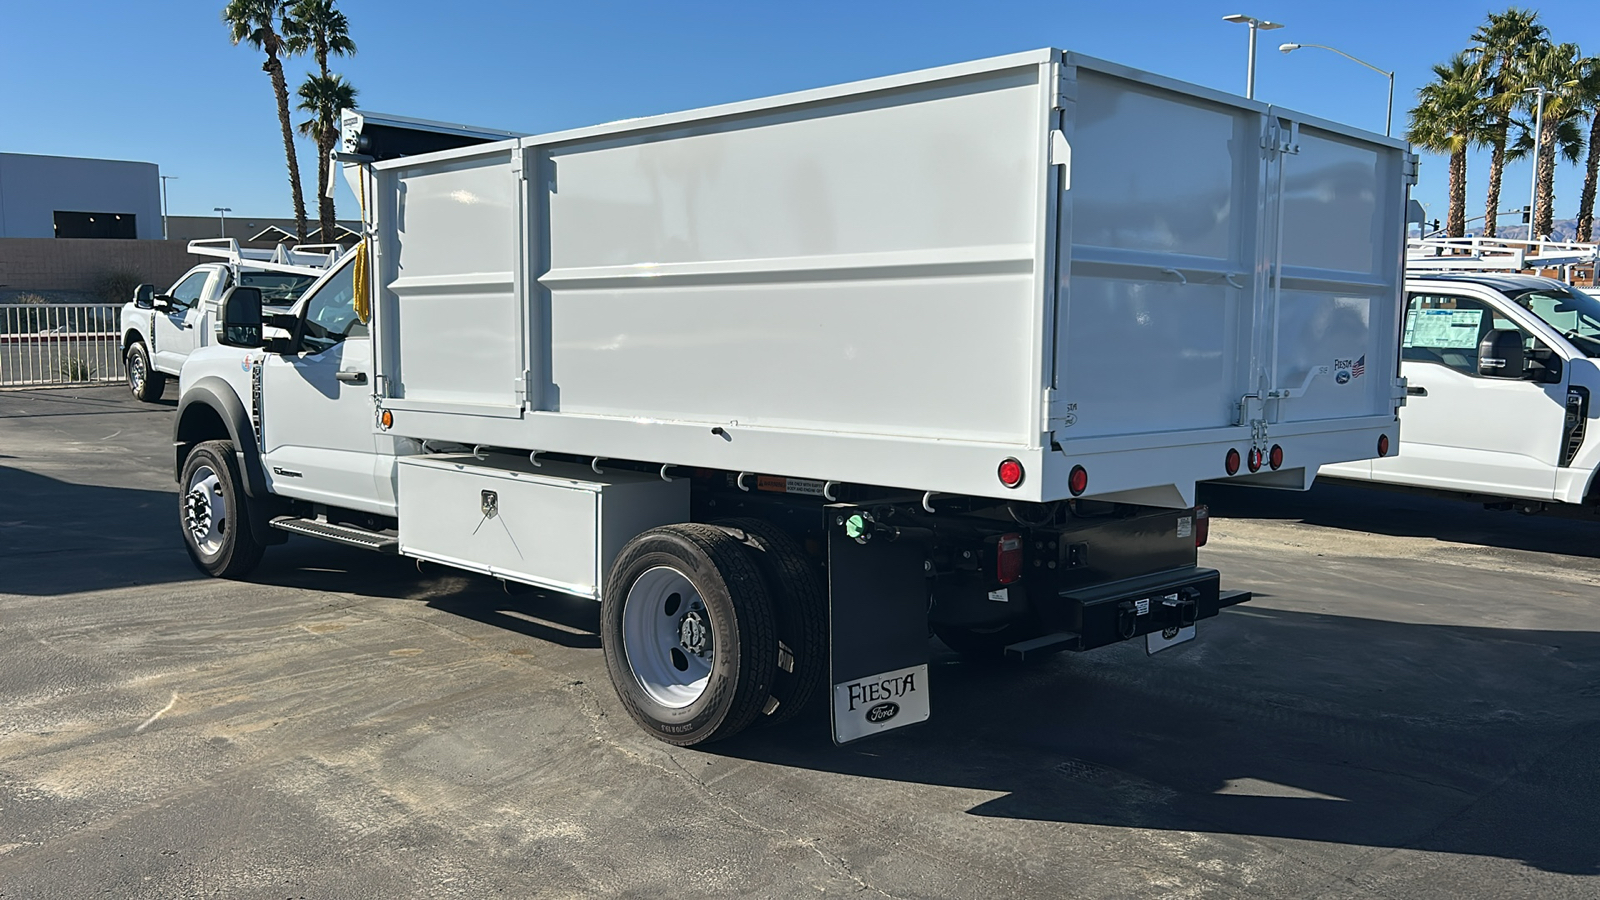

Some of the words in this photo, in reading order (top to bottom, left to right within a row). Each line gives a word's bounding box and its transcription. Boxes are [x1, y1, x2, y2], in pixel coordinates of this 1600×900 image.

[1334, 358, 1352, 371] FIESTA
[847, 672, 916, 712] FIESTA
[871, 704, 895, 721] Ford
